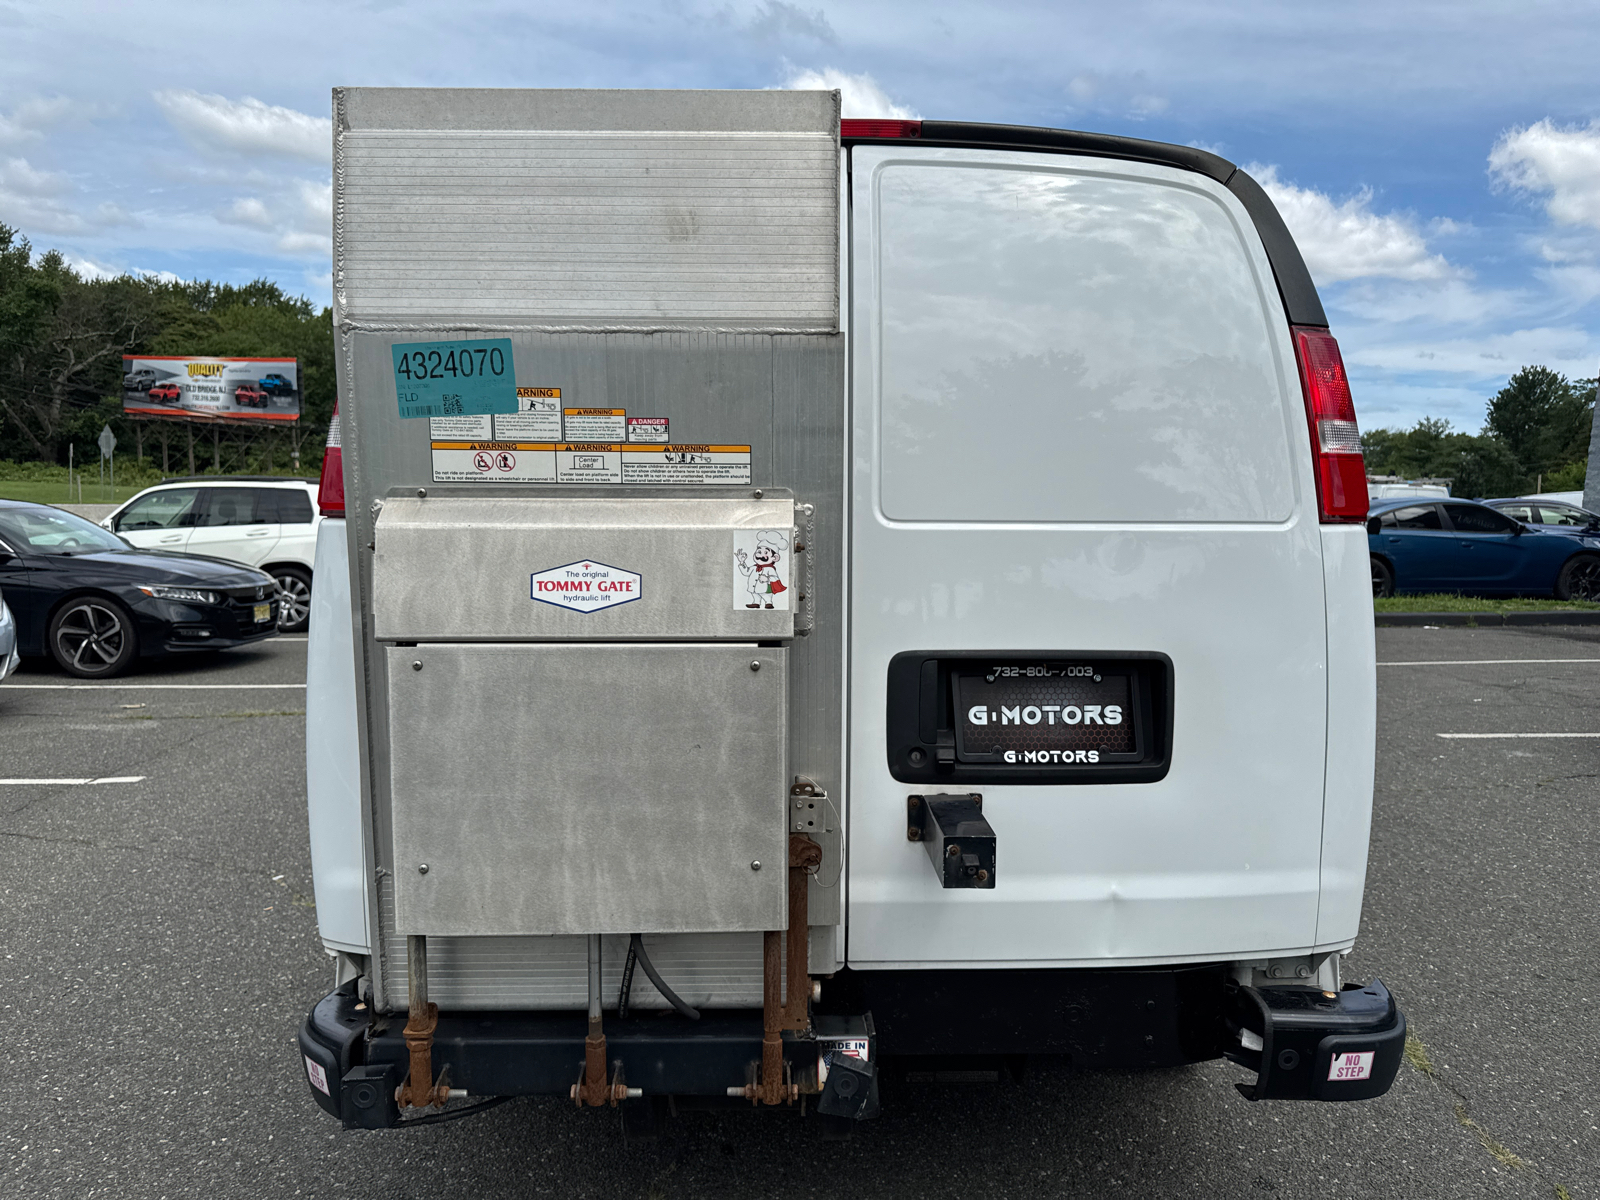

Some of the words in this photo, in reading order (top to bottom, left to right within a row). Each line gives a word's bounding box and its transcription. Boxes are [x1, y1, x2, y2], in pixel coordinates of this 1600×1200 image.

[188, 363, 224, 377] QUALITY
[398, 348, 505, 380] 4324070
[536, 581, 592, 592] TOMMY
[1345, 1055, 1360, 1066] NO
[310, 1062, 319, 1076] NO
[1337, 1066, 1364, 1077] STEP
